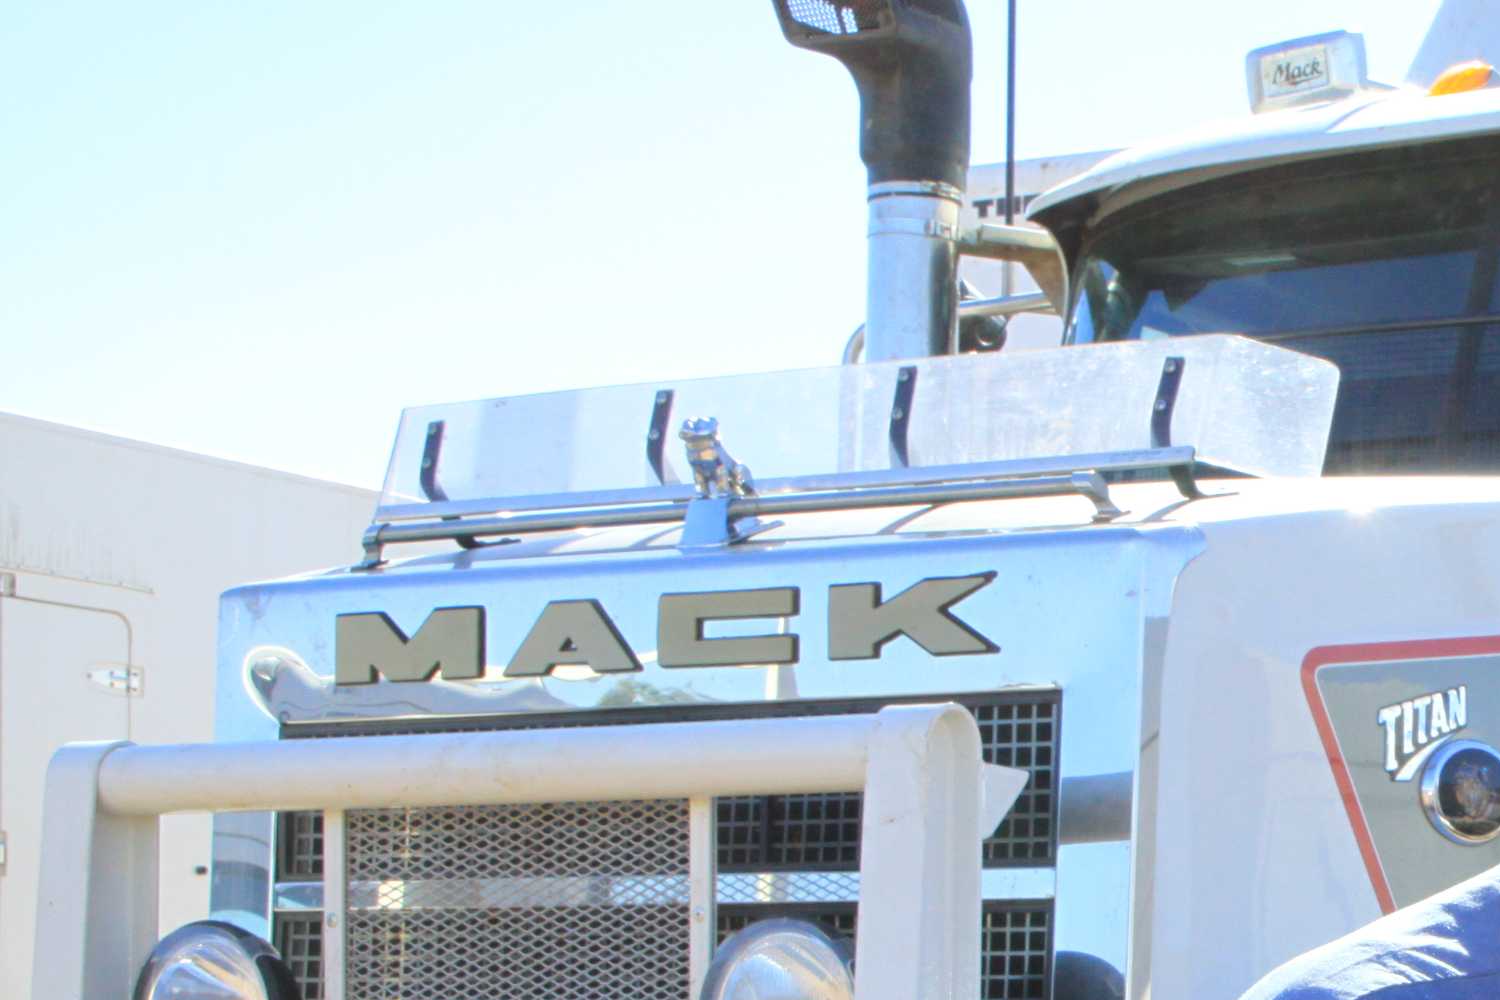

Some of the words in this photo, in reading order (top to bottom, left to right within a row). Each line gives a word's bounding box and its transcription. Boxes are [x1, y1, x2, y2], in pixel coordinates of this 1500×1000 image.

[1271, 57, 1322, 85] Mack
[335, 570, 1000, 686] MACK
[1377, 685, 1467, 771] TITAN
